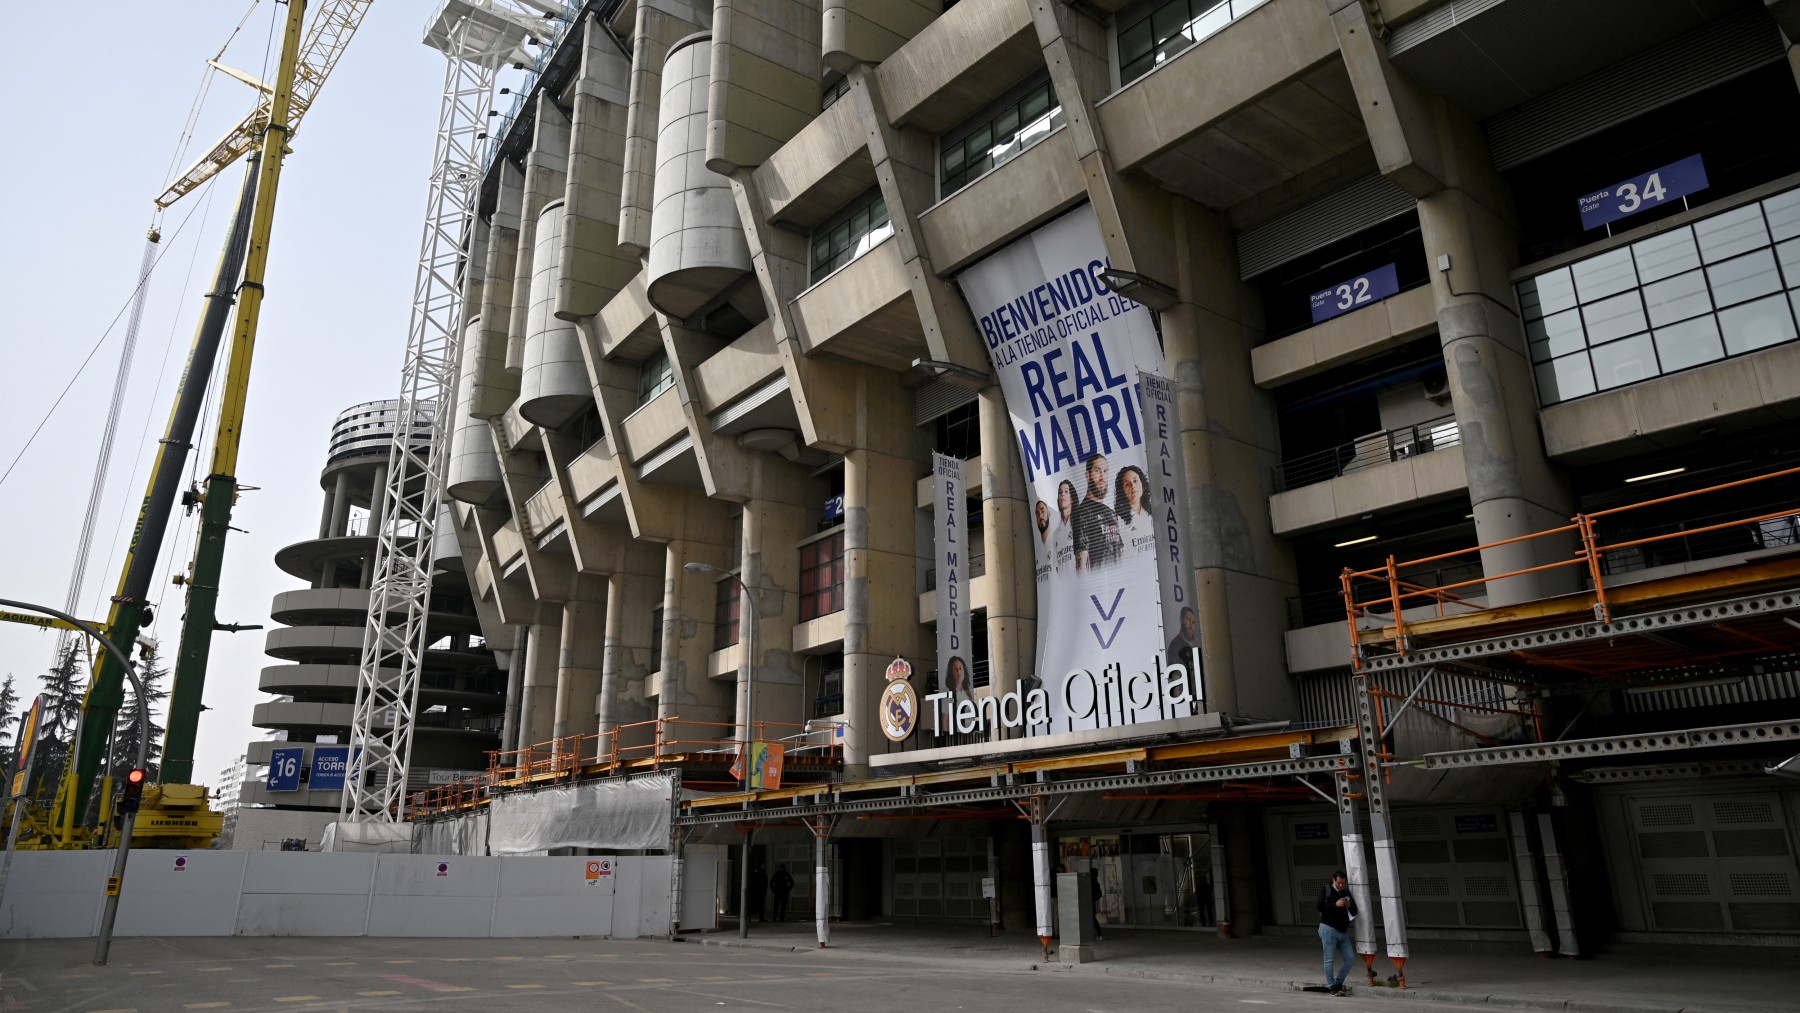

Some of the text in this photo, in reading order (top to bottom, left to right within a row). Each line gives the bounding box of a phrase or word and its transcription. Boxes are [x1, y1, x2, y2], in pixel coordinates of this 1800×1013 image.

[1579, 190, 1609, 206] Puerta
[1615, 172, 1667, 213] 34
[1581, 202, 1600, 213] Gate
[980, 256, 1113, 350] BIENVENIDO
[1311, 290, 1332, 302] Puerta
[1335, 277, 1372, 310] 32
[995, 294, 1140, 370] A LA TIENDA OFICIAL DEL
[1020, 331, 1127, 418] REAL
[1145, 376, 1170, 392] TIENDA
[1146, 387, 1173, 404] OFICIAL
[1018, 383, 1142, 483] MADRI
[938, 457, 960, 471] TIENDA
[938, 466, 961, 481] OFICIAL
[1155, 404, 1184, 603] REAL MADRID
[946, 480, 960, 651] REAL MADRID
[3, 612, 53, 625] AGUILAR
[925, 647, 1204, 738] Tienda Oficial
[277, 757, 296, 777] 16
[431, 772, 451, 781] Tour
